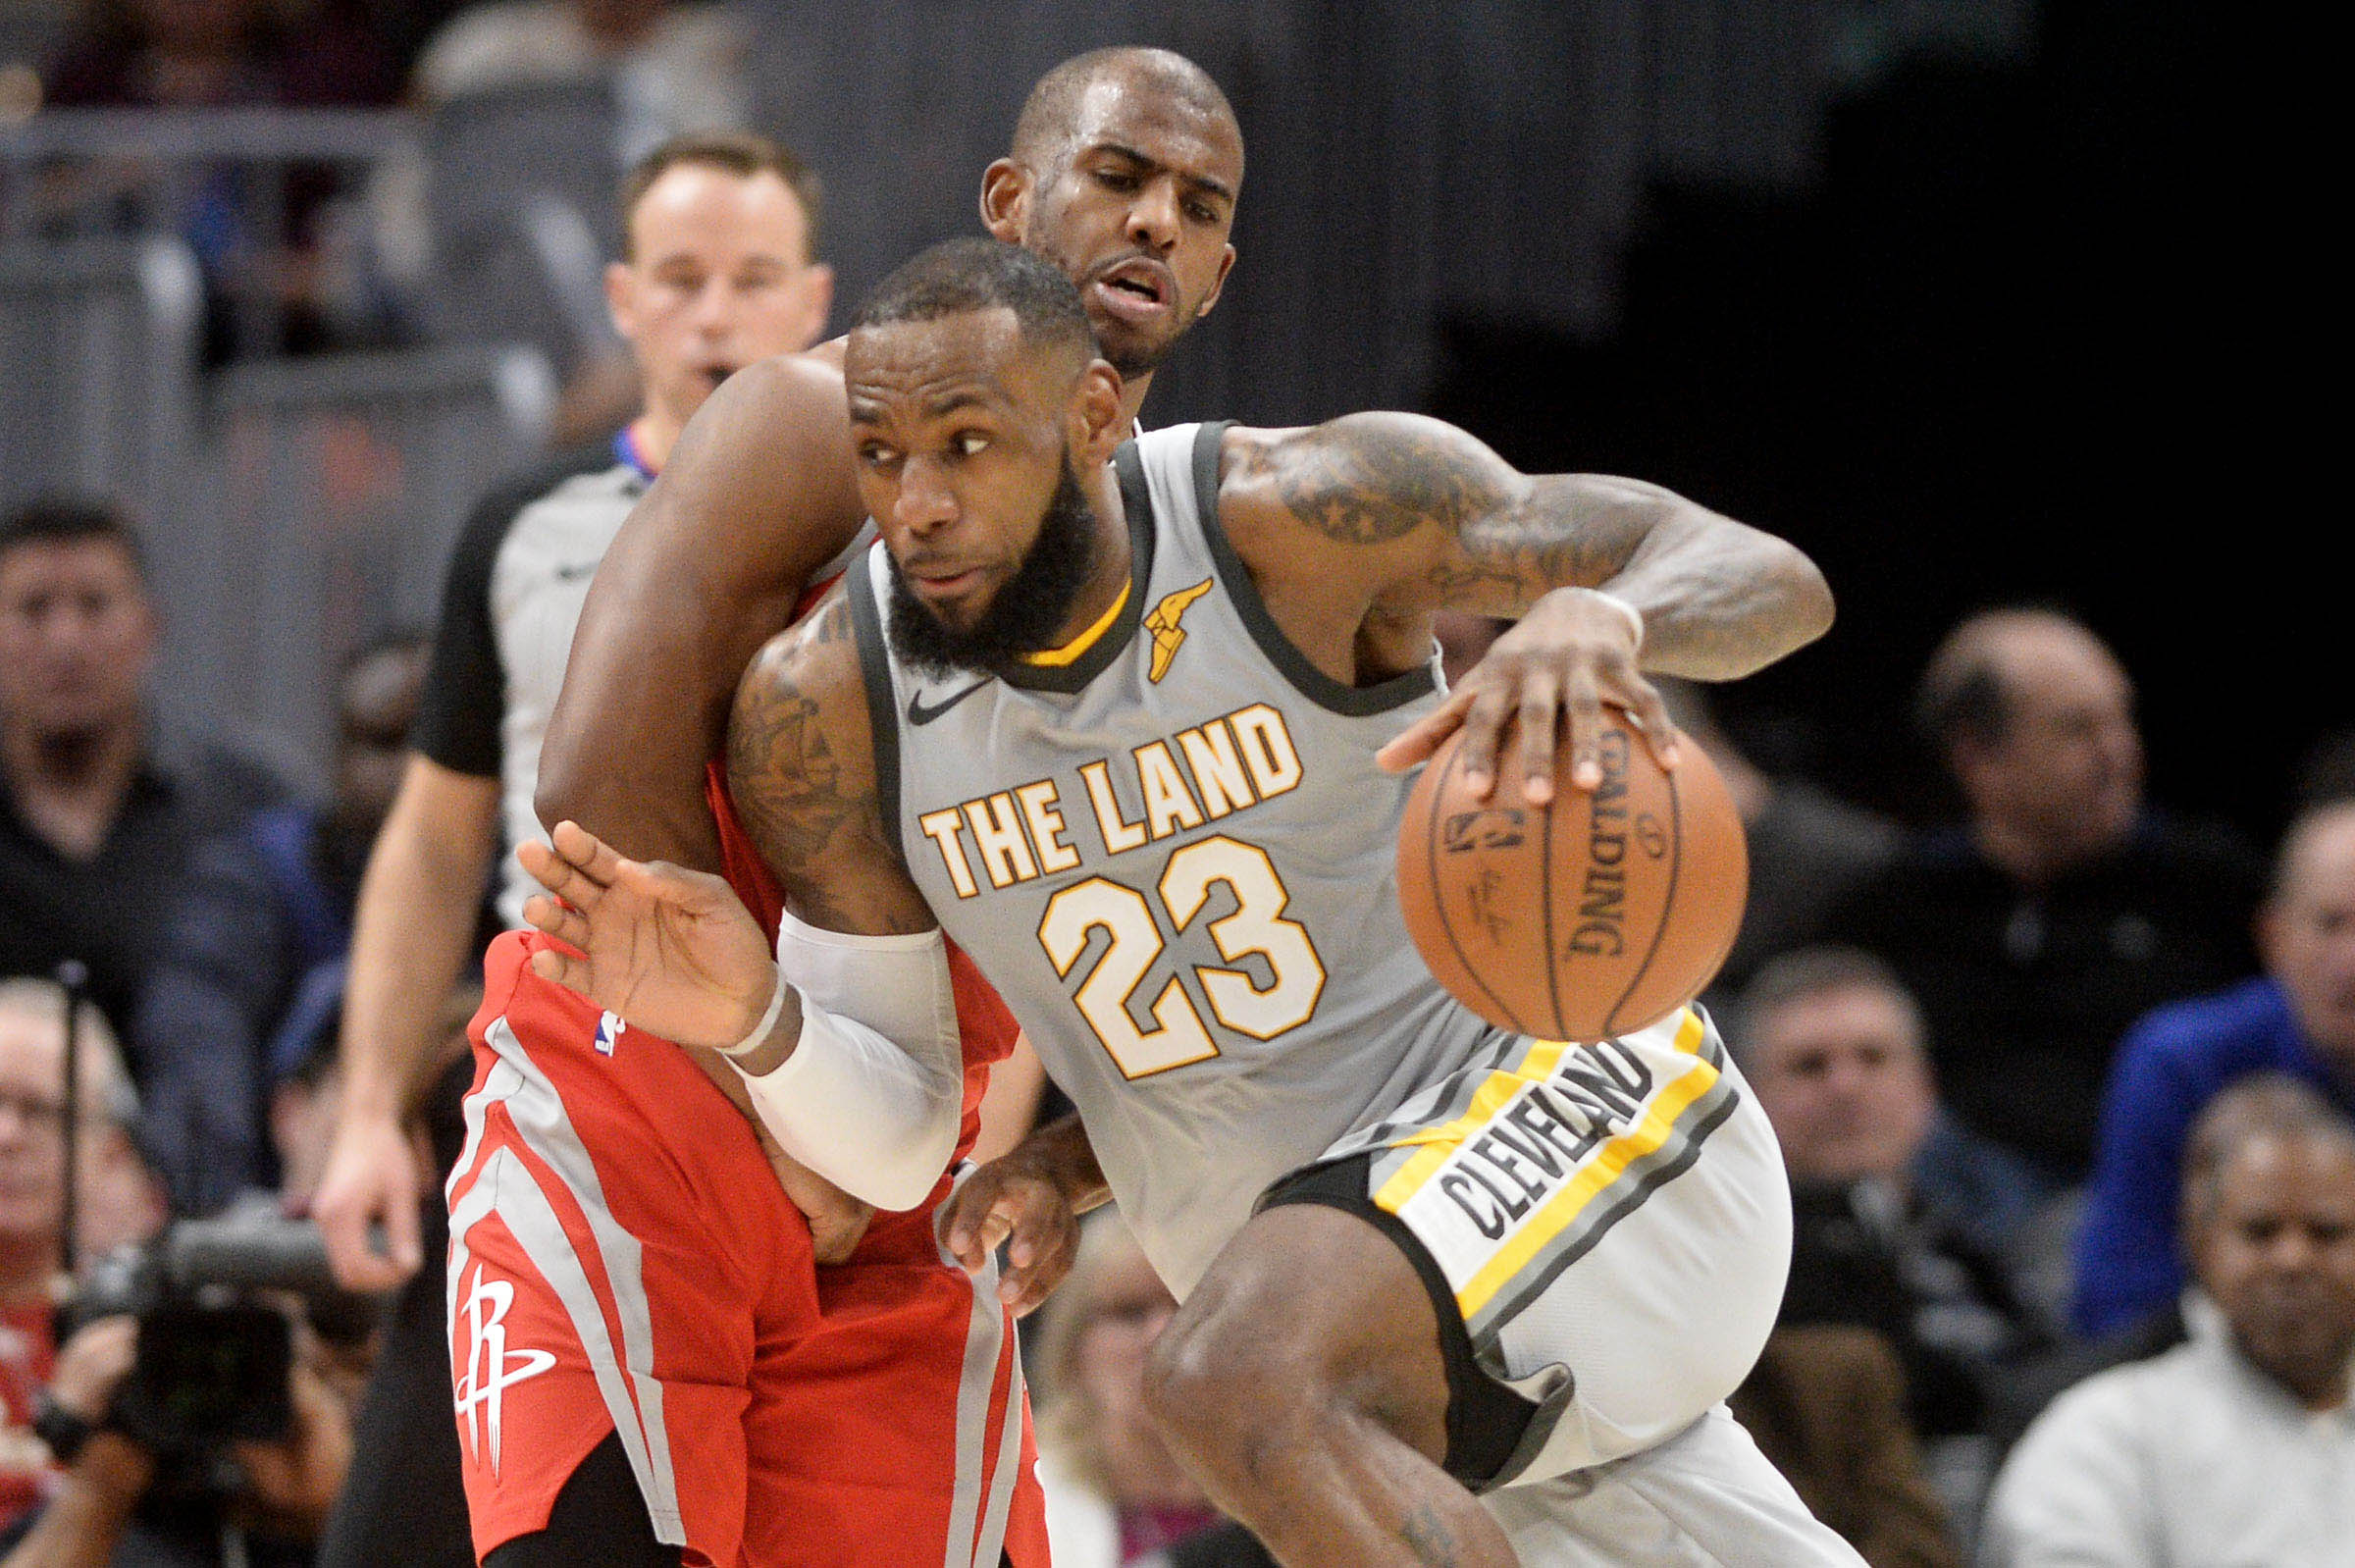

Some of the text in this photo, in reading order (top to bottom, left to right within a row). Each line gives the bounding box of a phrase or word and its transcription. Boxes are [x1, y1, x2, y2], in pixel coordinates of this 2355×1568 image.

[919, 703, 1304, 899] THE LAND
[1037, 834, 1328, 1080] 23
[1440, 1040, 1652, 1240] CLEVELAND
